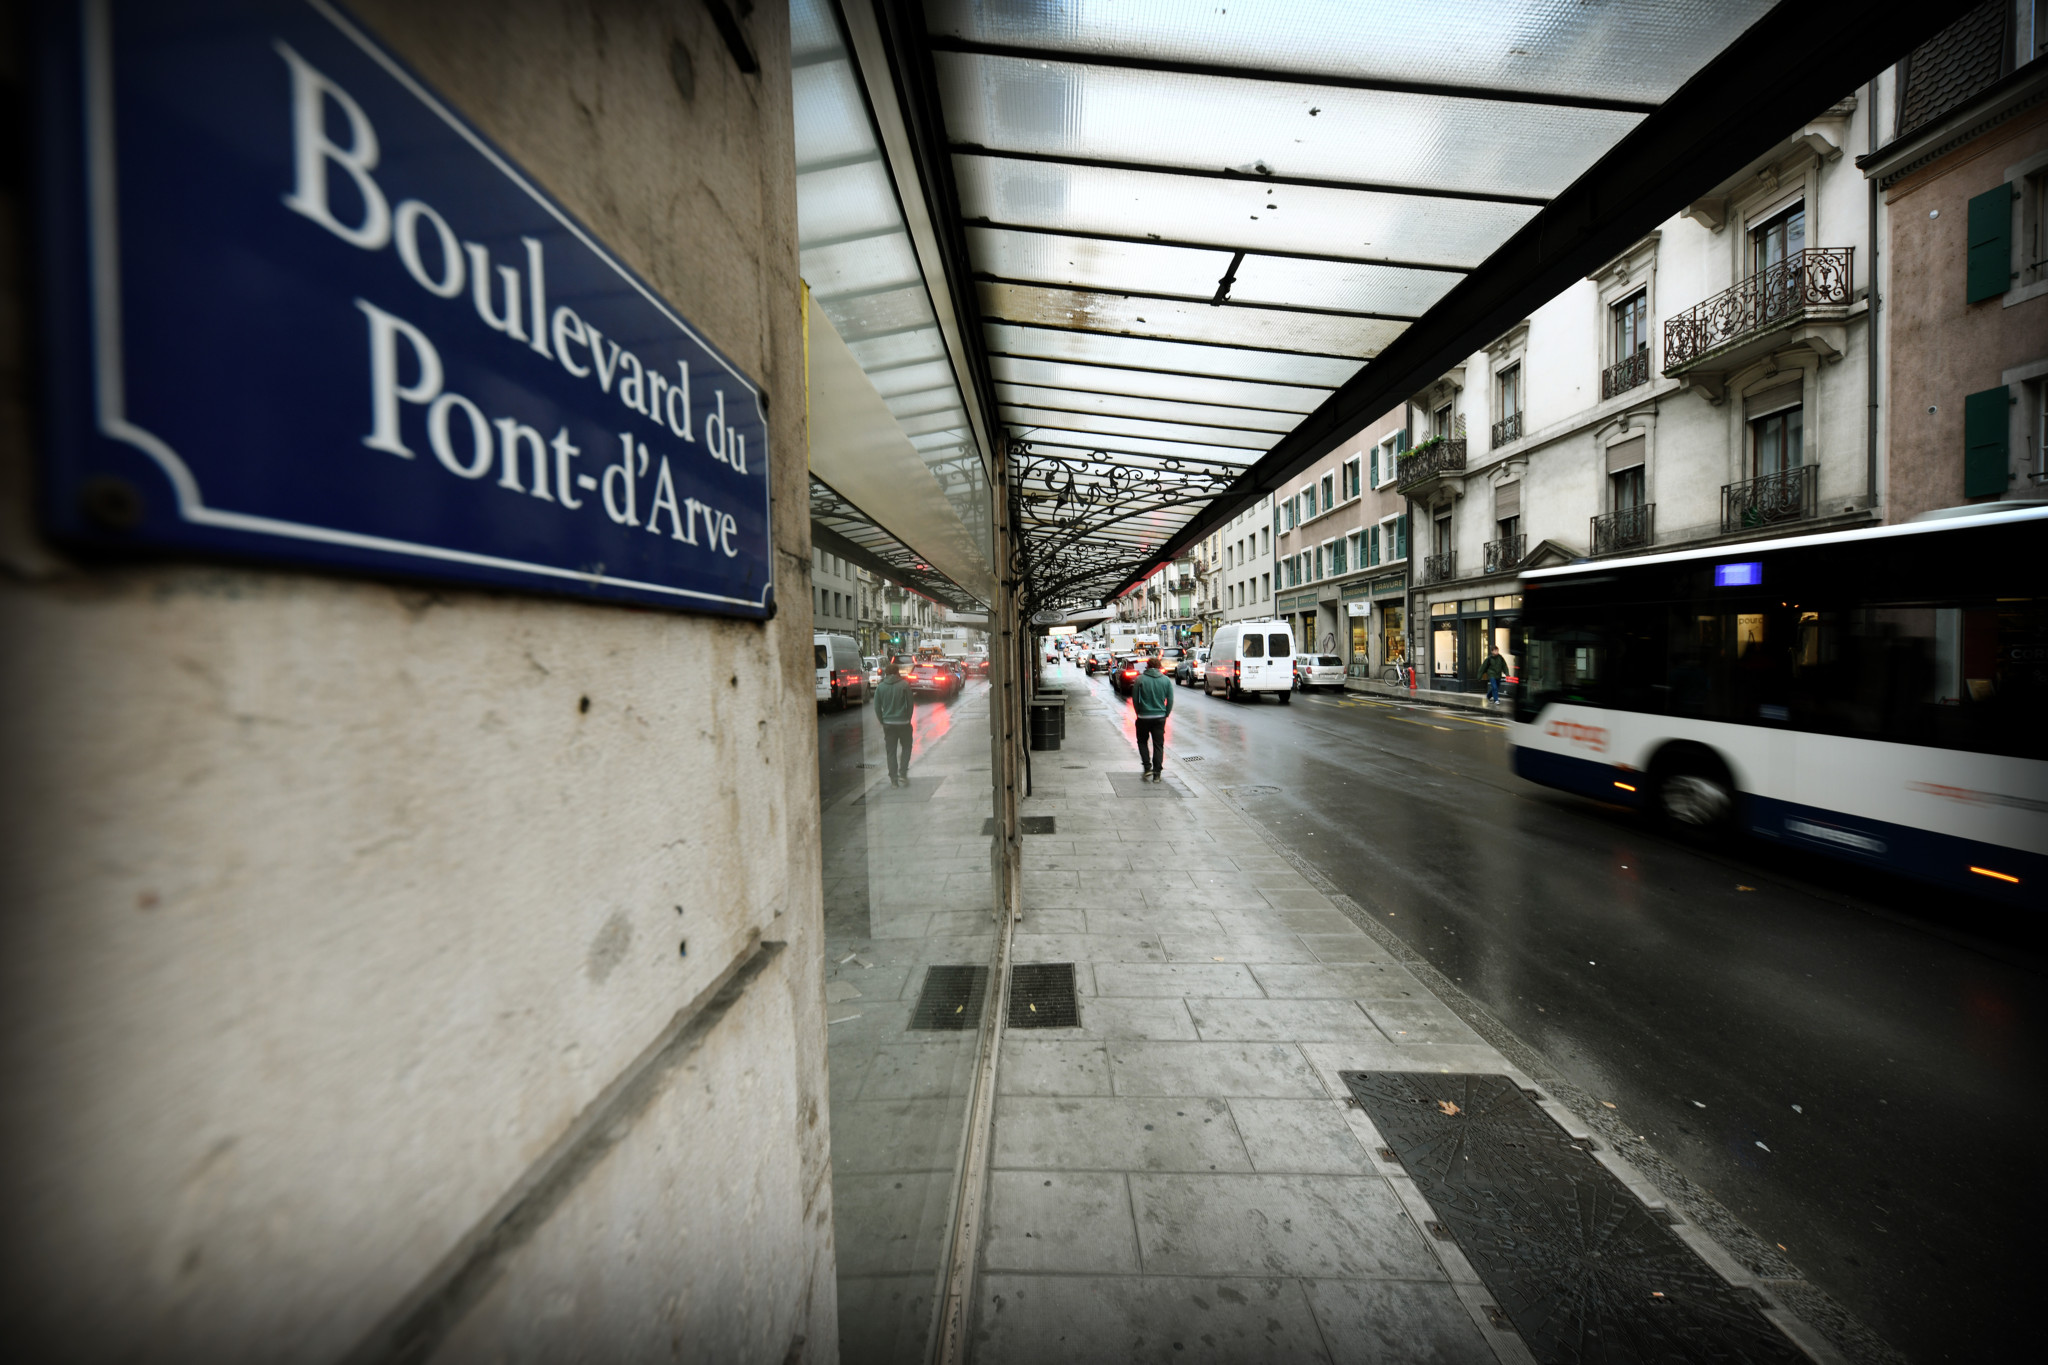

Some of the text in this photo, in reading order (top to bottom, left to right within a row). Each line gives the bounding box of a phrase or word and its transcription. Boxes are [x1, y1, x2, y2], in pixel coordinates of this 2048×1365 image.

[272, 36, 748, 475] Boulevard du
[354, 297, 739, 559] Pont-d'Arve
[1374, 578, 1403, 591] GRAVURE
